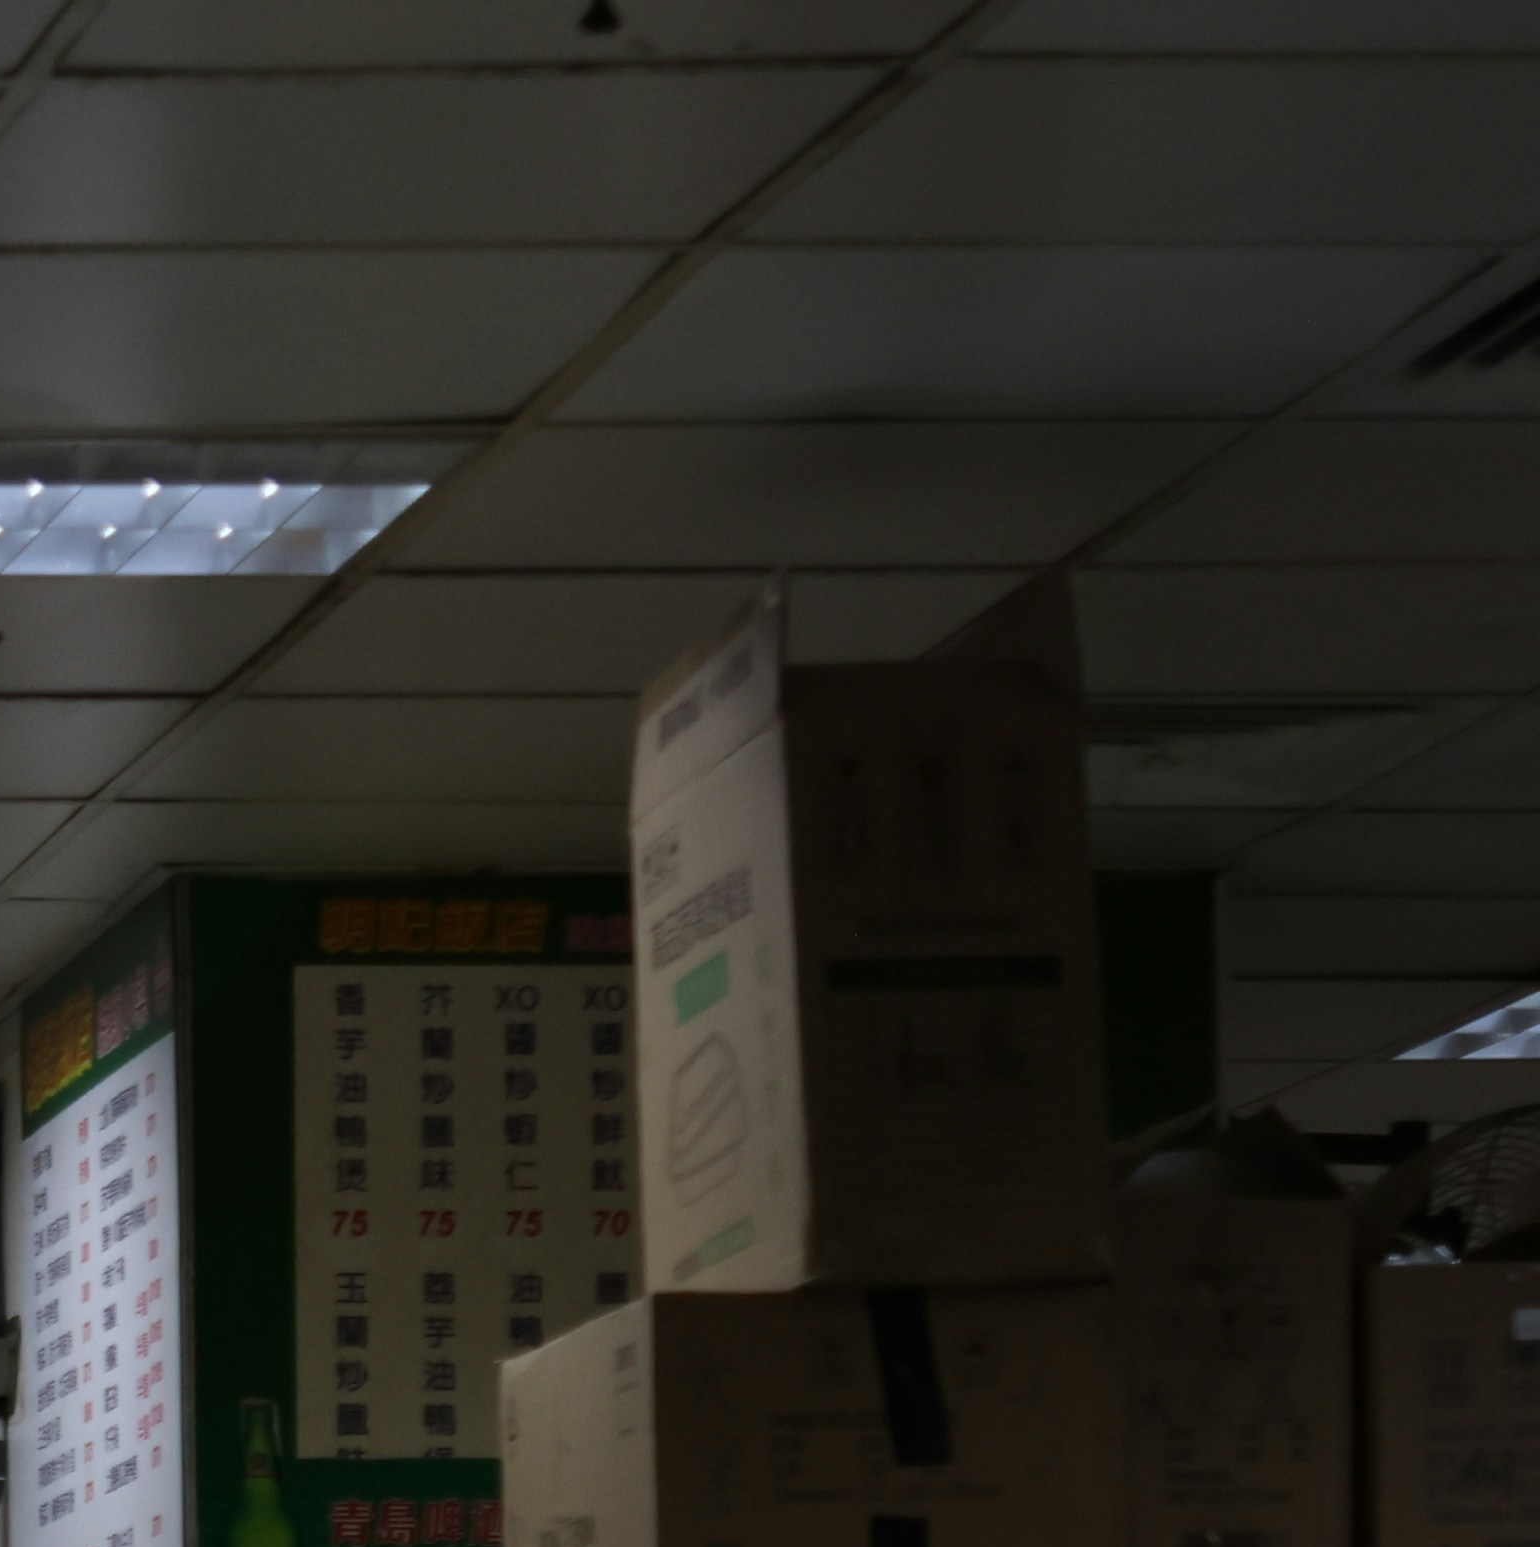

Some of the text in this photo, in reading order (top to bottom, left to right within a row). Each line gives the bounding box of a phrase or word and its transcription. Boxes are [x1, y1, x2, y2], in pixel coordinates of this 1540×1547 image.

[331, 1210, 368, 1238] 75
[419, 1210, 456, 1238] 75
[505, 1210, 544, 1238] 75
[591, 1210, 631, 1238] 70
